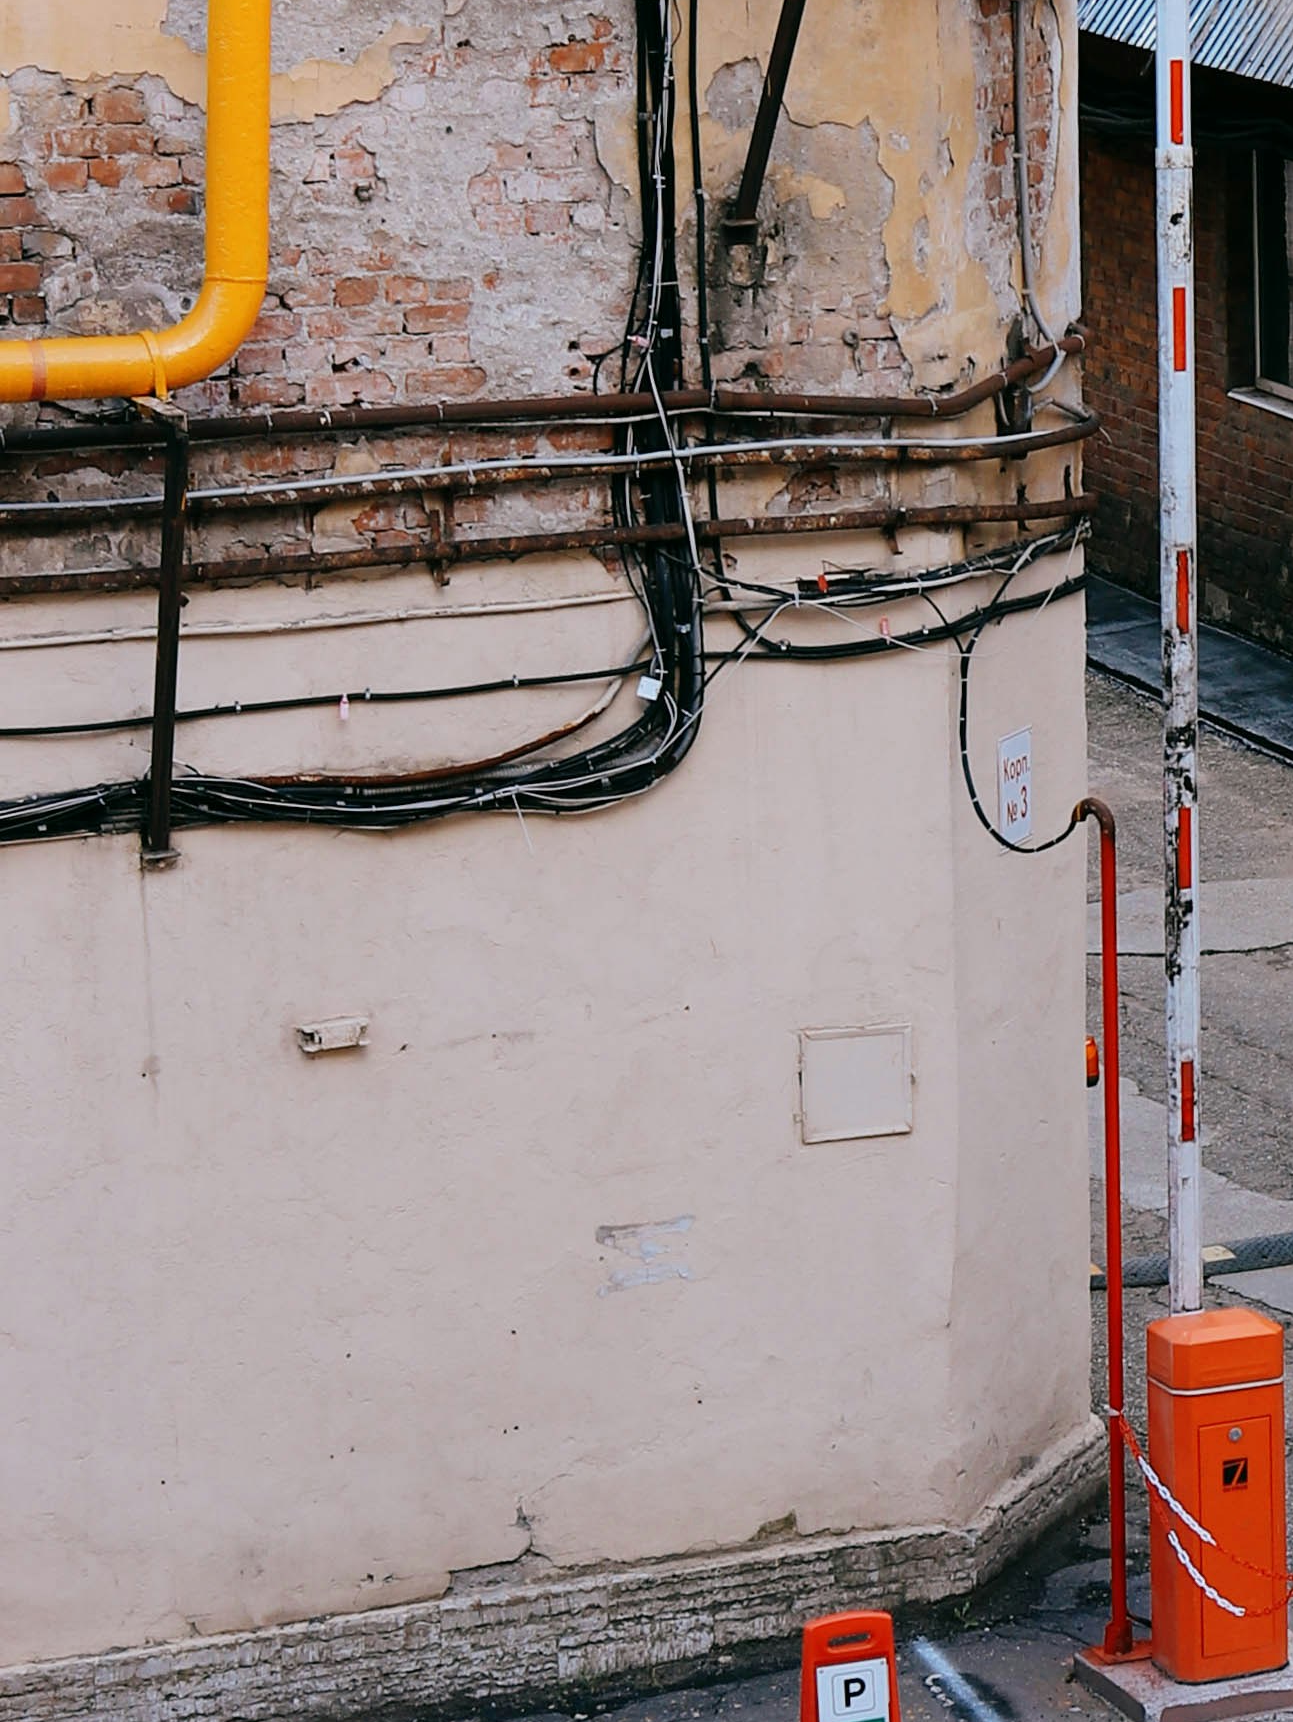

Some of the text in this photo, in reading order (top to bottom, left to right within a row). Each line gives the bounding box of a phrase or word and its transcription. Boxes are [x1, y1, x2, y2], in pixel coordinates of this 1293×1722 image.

[1003, 756, 1030, 783] Корп.
[1020, 784, 1028, 819] 3
[843, 1677, 866, 1708] P
